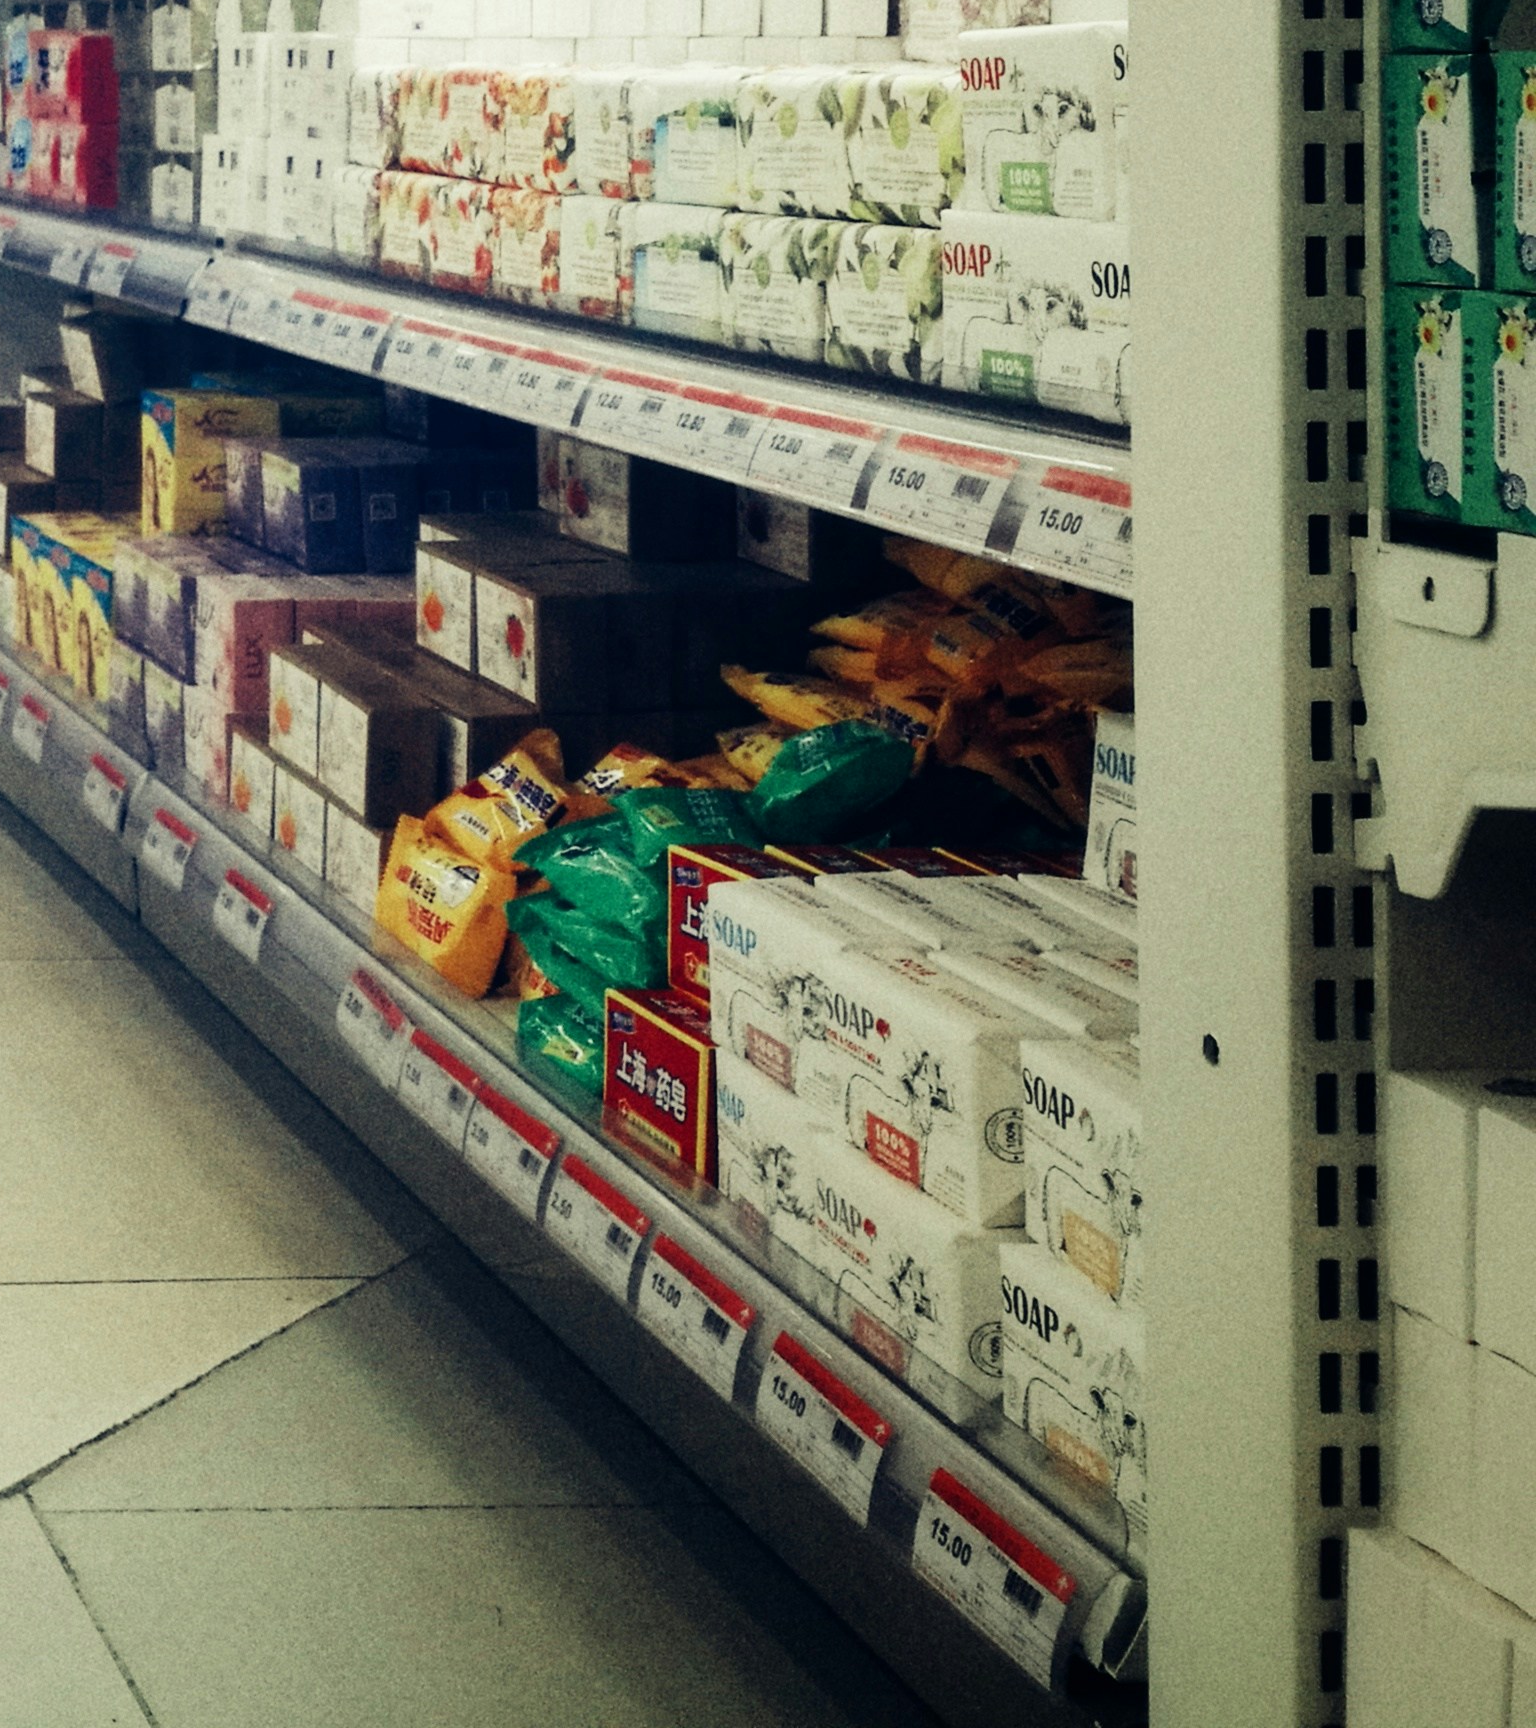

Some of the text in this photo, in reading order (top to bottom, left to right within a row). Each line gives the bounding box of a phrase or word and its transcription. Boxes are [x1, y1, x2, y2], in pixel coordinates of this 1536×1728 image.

[961, 57, 1006, 92] SOAP
[943, 242, 992, 278] SOAP
[596, 392, 624, 414] 12.80
[676, 412, 706, 432] 12.80
[771, 433, 803, 456] 12.80
[887, 465, 927, 492] 15.00
[1038, 506, 1084, 536] 15.00
[713, 911, 757, 957] SOAP
[826, 993, 874, 1041] SOAP
[1023, 1068, 1075, 1131] SOAP
[873, 1121, 913, 1160] 100%
[817, 1178, 863, 1238] SOAP
[649, 1271, 682, 1310] 15.00
[1001, 1275, 1060, 1343] SOAP
[772, 1372, 809, 1419] 15.00
[930, 1516, 973, 1568] 15.00
